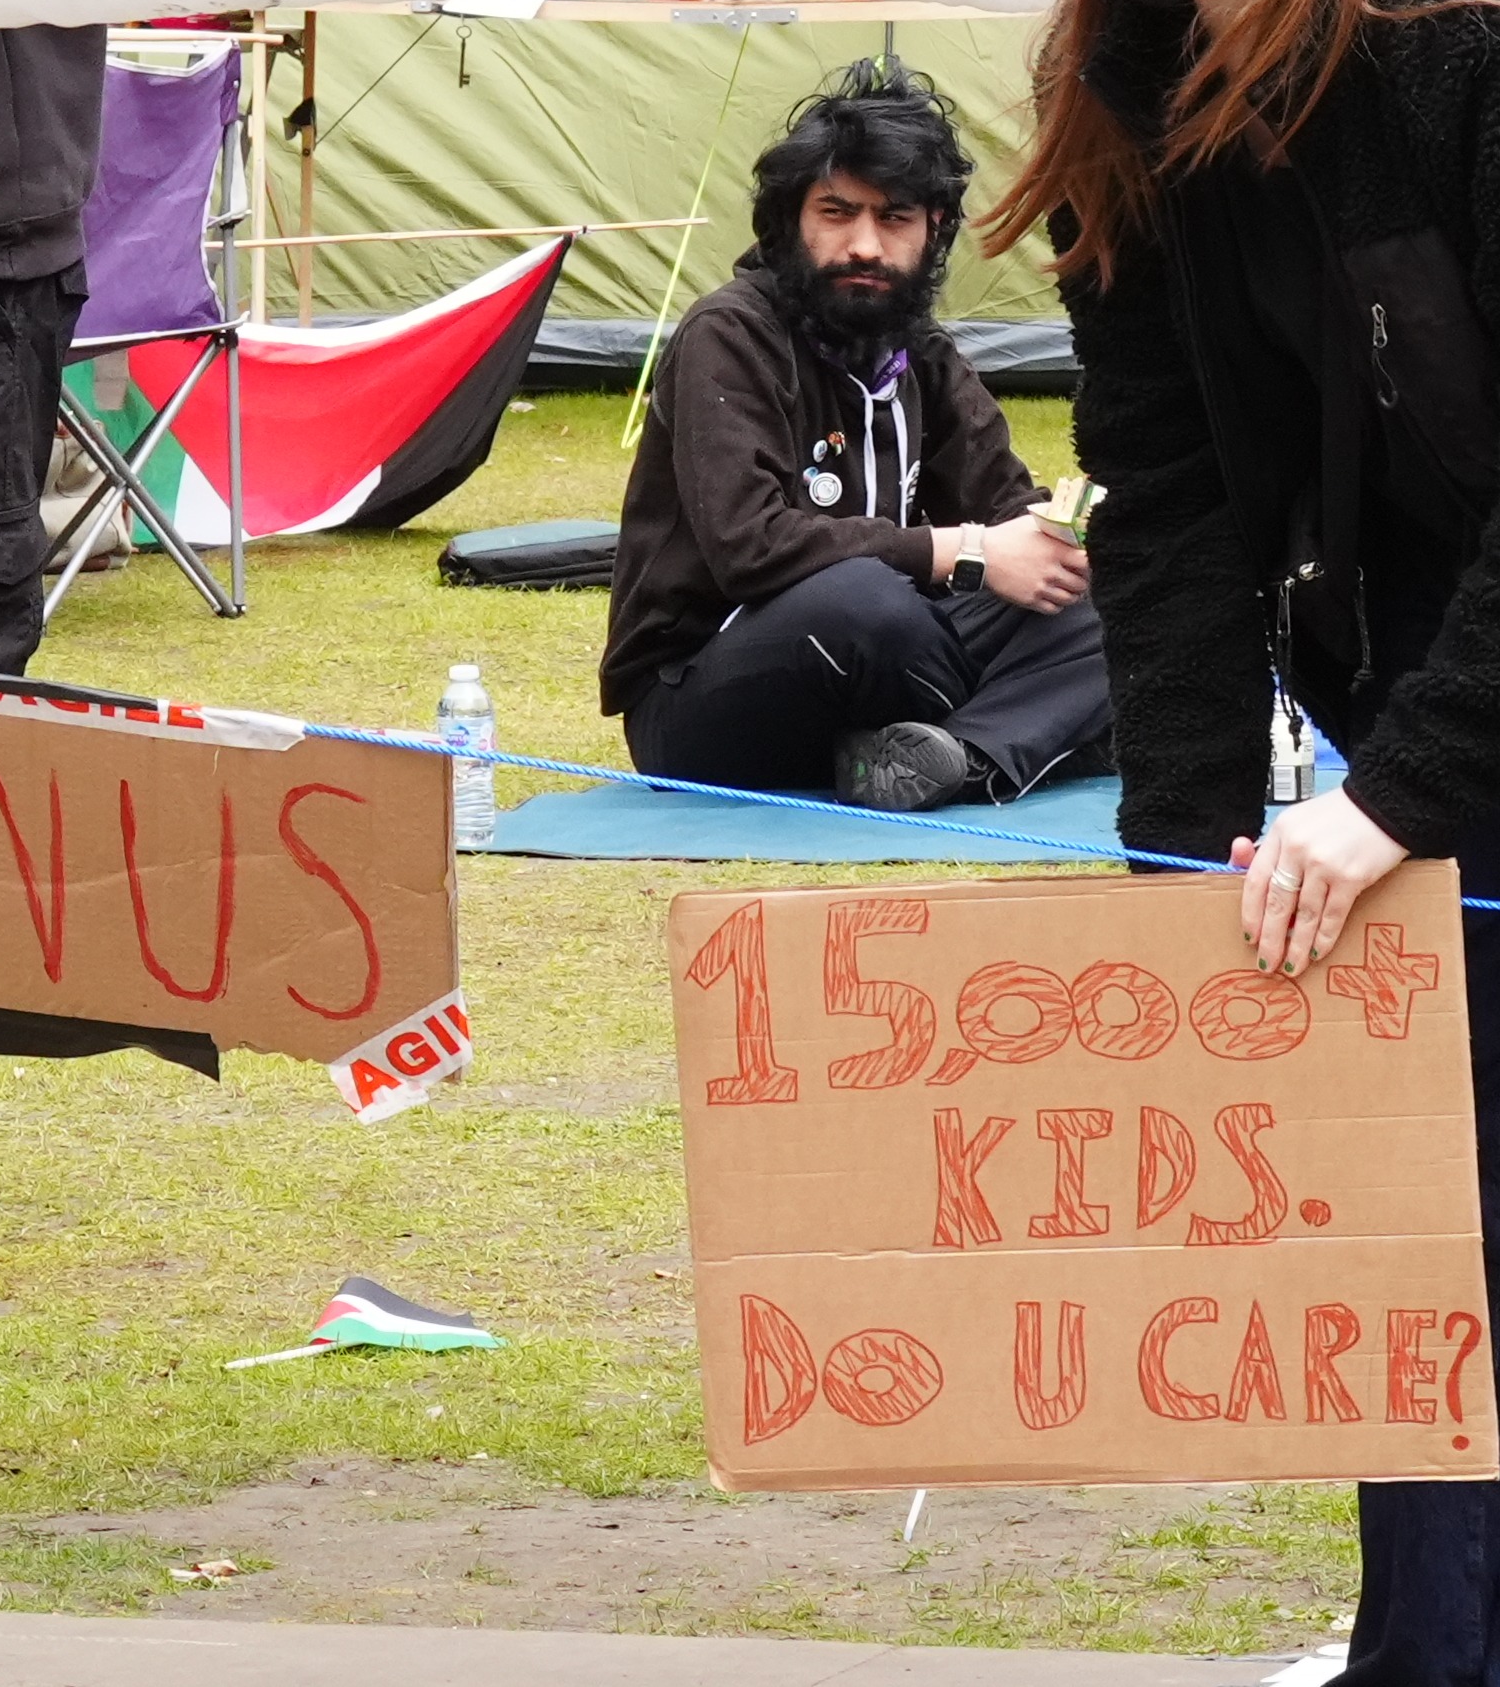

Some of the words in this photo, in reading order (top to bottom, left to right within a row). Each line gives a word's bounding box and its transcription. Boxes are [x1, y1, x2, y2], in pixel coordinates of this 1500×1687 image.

[119, 779, 384, 1022] US
[684, 898, 1440, 1105] 15,000+
[932, 1101, 1334, 1249] KIDS.
[1013, 1300, 1088, 1431] U
[1137, 1295, 1483, 1451] CARE?
